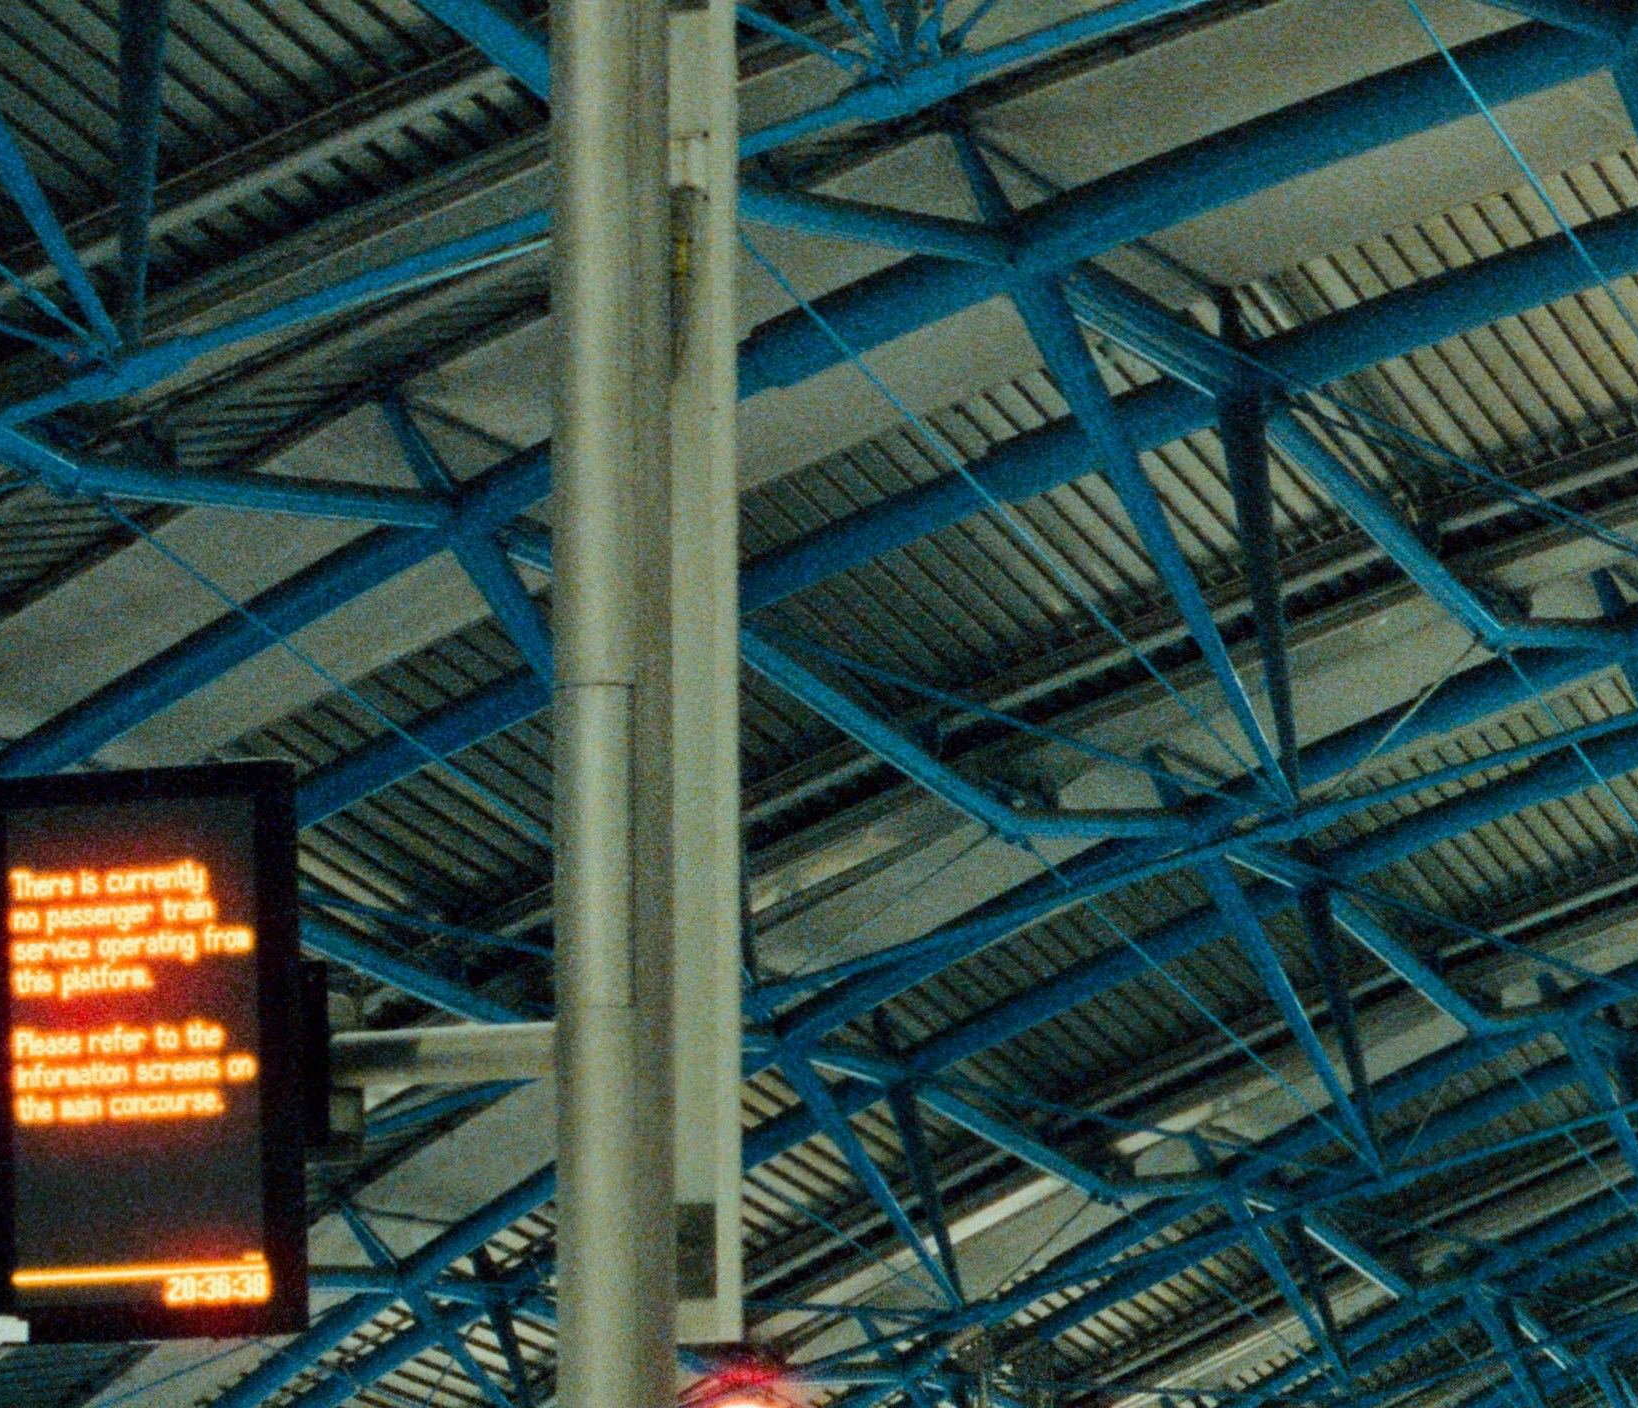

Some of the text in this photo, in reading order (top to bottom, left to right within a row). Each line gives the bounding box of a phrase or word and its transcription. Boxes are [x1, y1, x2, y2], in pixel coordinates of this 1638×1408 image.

[12, 859, 207, 898] There is currently
[13, 897, 214, 936] no passenger train
[14, 924, 252, 963] service operating from
[14, 964, 155, 998] this platform.
[14, 1020, 223, 1058] Please refer to the
[17, 1055, 257, 1090] information screens on
[17, 1090, 226, 1123] the main concourse.
[166, 1273, 270, 1305] 20:36:38
